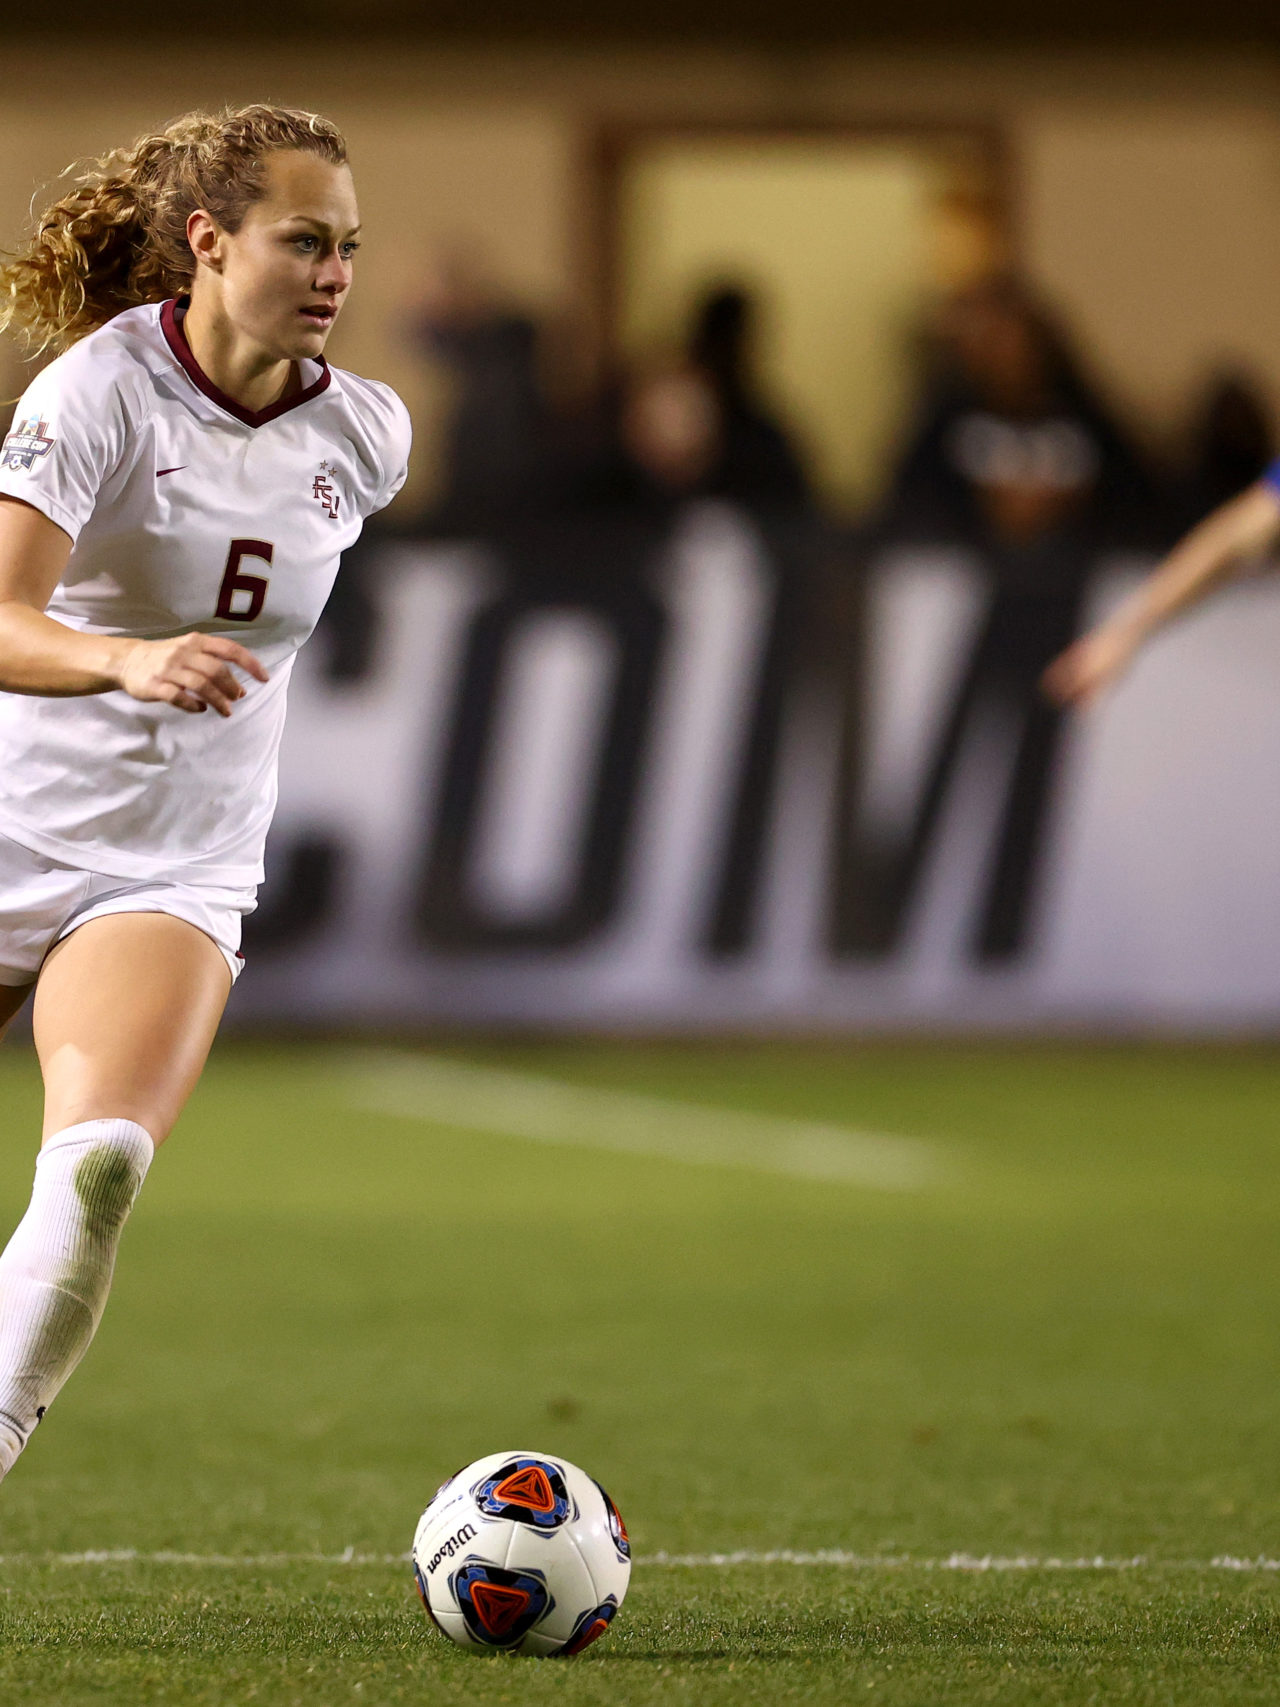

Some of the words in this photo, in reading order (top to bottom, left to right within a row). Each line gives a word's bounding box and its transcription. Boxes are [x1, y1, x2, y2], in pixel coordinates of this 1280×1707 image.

[312, 475, 340, 519] FSU
[214, 537, 274, 622] 6
[427, 1523, 478, 1574] Wilson
